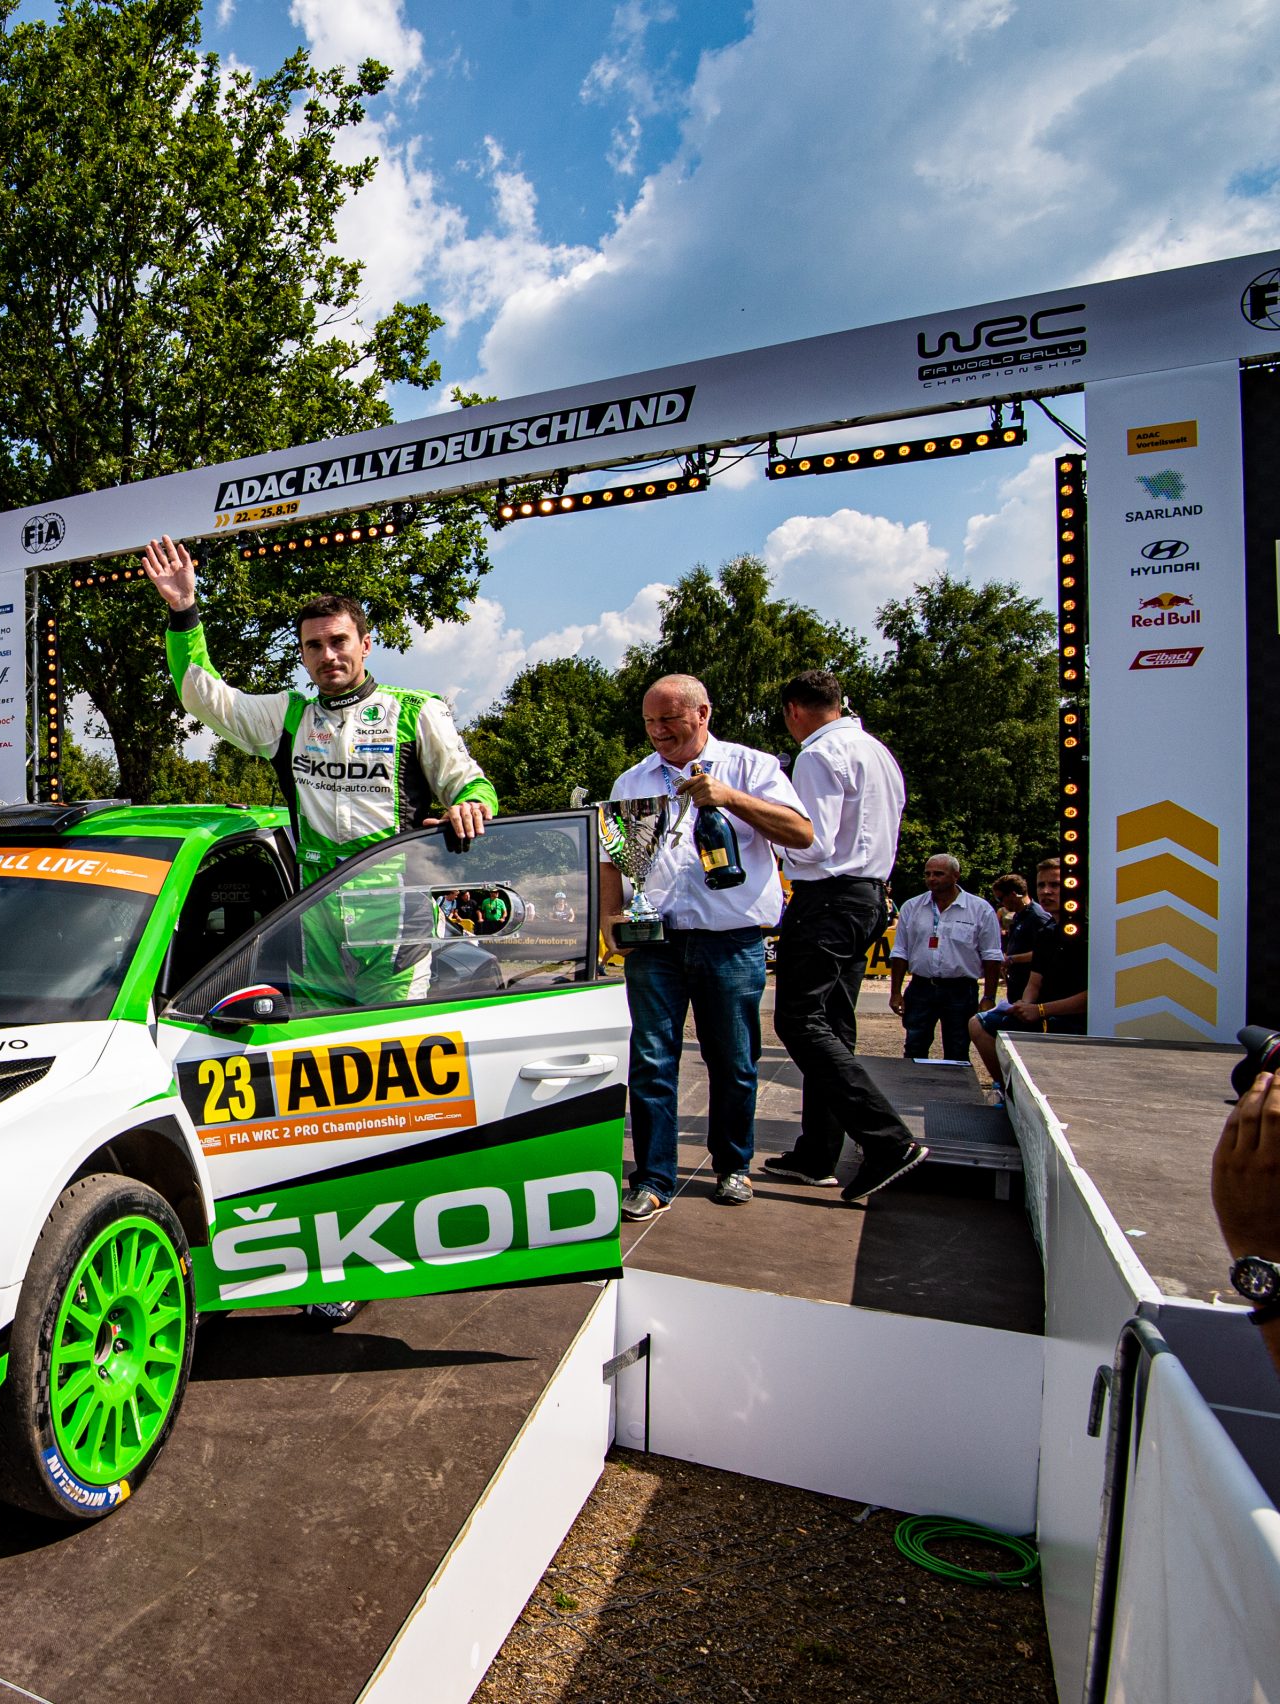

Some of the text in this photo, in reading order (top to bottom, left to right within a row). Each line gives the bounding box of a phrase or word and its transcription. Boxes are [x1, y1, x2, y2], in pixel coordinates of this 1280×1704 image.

[917, 303, 1087, 359] WRC
[923, 344, 1082, 377] FIA WORLD RALLY
[923, 359, 1082, 389] CHAMPIONSHIP
[1136, 431, 1160, 440] ADAC
[1136, 437, 1188, 449] Vorteilswelt
[220, 394, 687, 510] ADAC RALLYE DEUTSCHLAND
[234, 511, 252, 524] 22.
[260, 502, 298, 519] 25.8.19
[1125, 504, 1203, 524] SAARLAND
[1130, 562, 1200, 577] HYUNDAI
[1131, 609, 1201, 628] Red Bull
[1138, 651, 1193, 667] Eibach
[330, 695, 360, 707] ŠKODA
[293, 754, 390, 780] ŠKODA
[40, 856, 100, 876] LIVE
[198, 1035, 460, 1124] 23 ADAC
[229, 1132, 250, 1144] FIA
[252, 1128, 279, 1142] WRC
[282, 1127, 291, 1138] 2
[294, 1123, 319, 1136] PRO
[322, 1115, 407, 1133] Championship
[45, 1454, 107, 1508] MICHELIN
